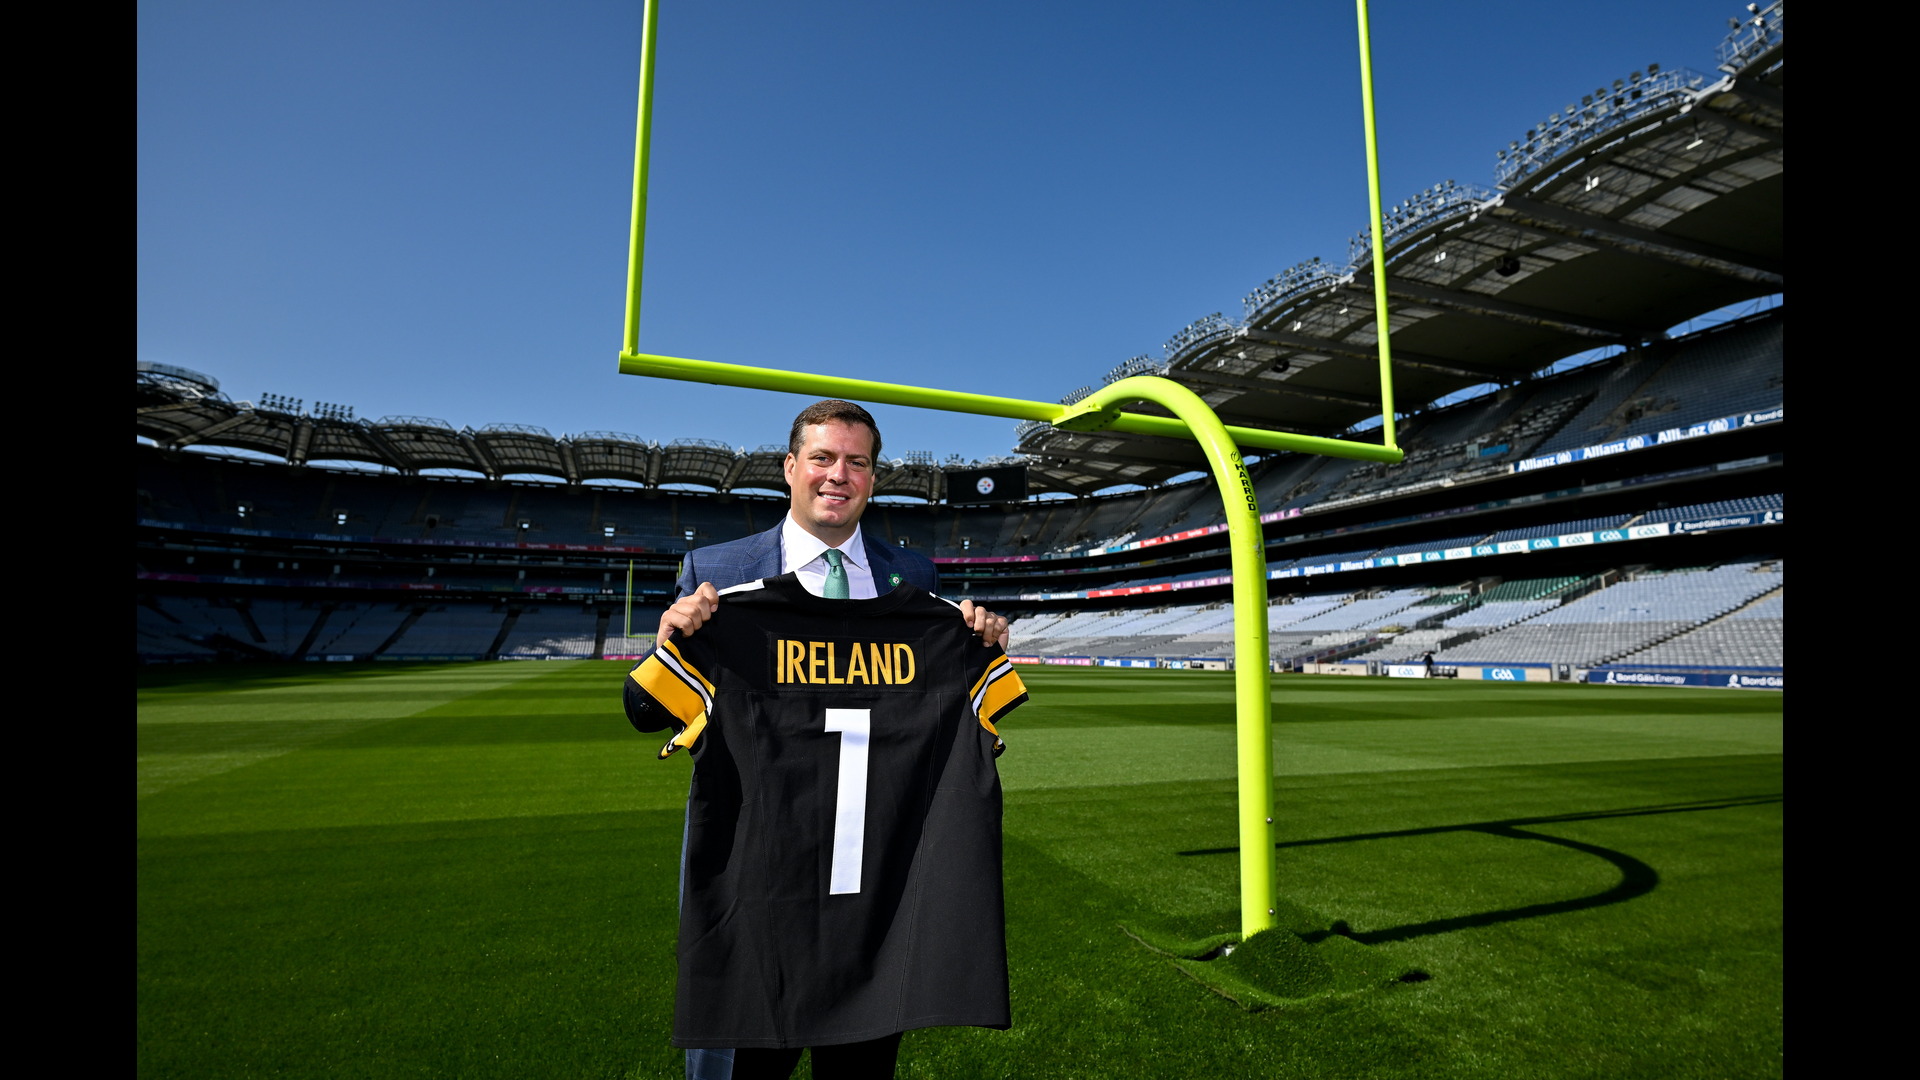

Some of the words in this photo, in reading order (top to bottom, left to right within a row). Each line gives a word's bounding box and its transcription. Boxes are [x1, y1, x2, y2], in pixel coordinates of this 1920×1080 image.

[1583, 441, 1625, 460] Allianz
[1518, 455, 1555, 472] Allianz
[1235, 464, 1256, 511] HARROD
[1600, 529, 1622, 541] GAA
[1533, 538, 1553, 549] GAA
[1476, 545, 1494, 555] GAA
[1340, 560, 1363, 571] Allianz
[776, 639, 916, 685] IRELAND
[1491, 668, 1515, 681] GAA
[1616, 673, 1636, 682] Bord
[1655, 673, 1686, 685] Energy
[1741, 676, 1766, 686] Bord
[824, 707, 871, 895] 1
